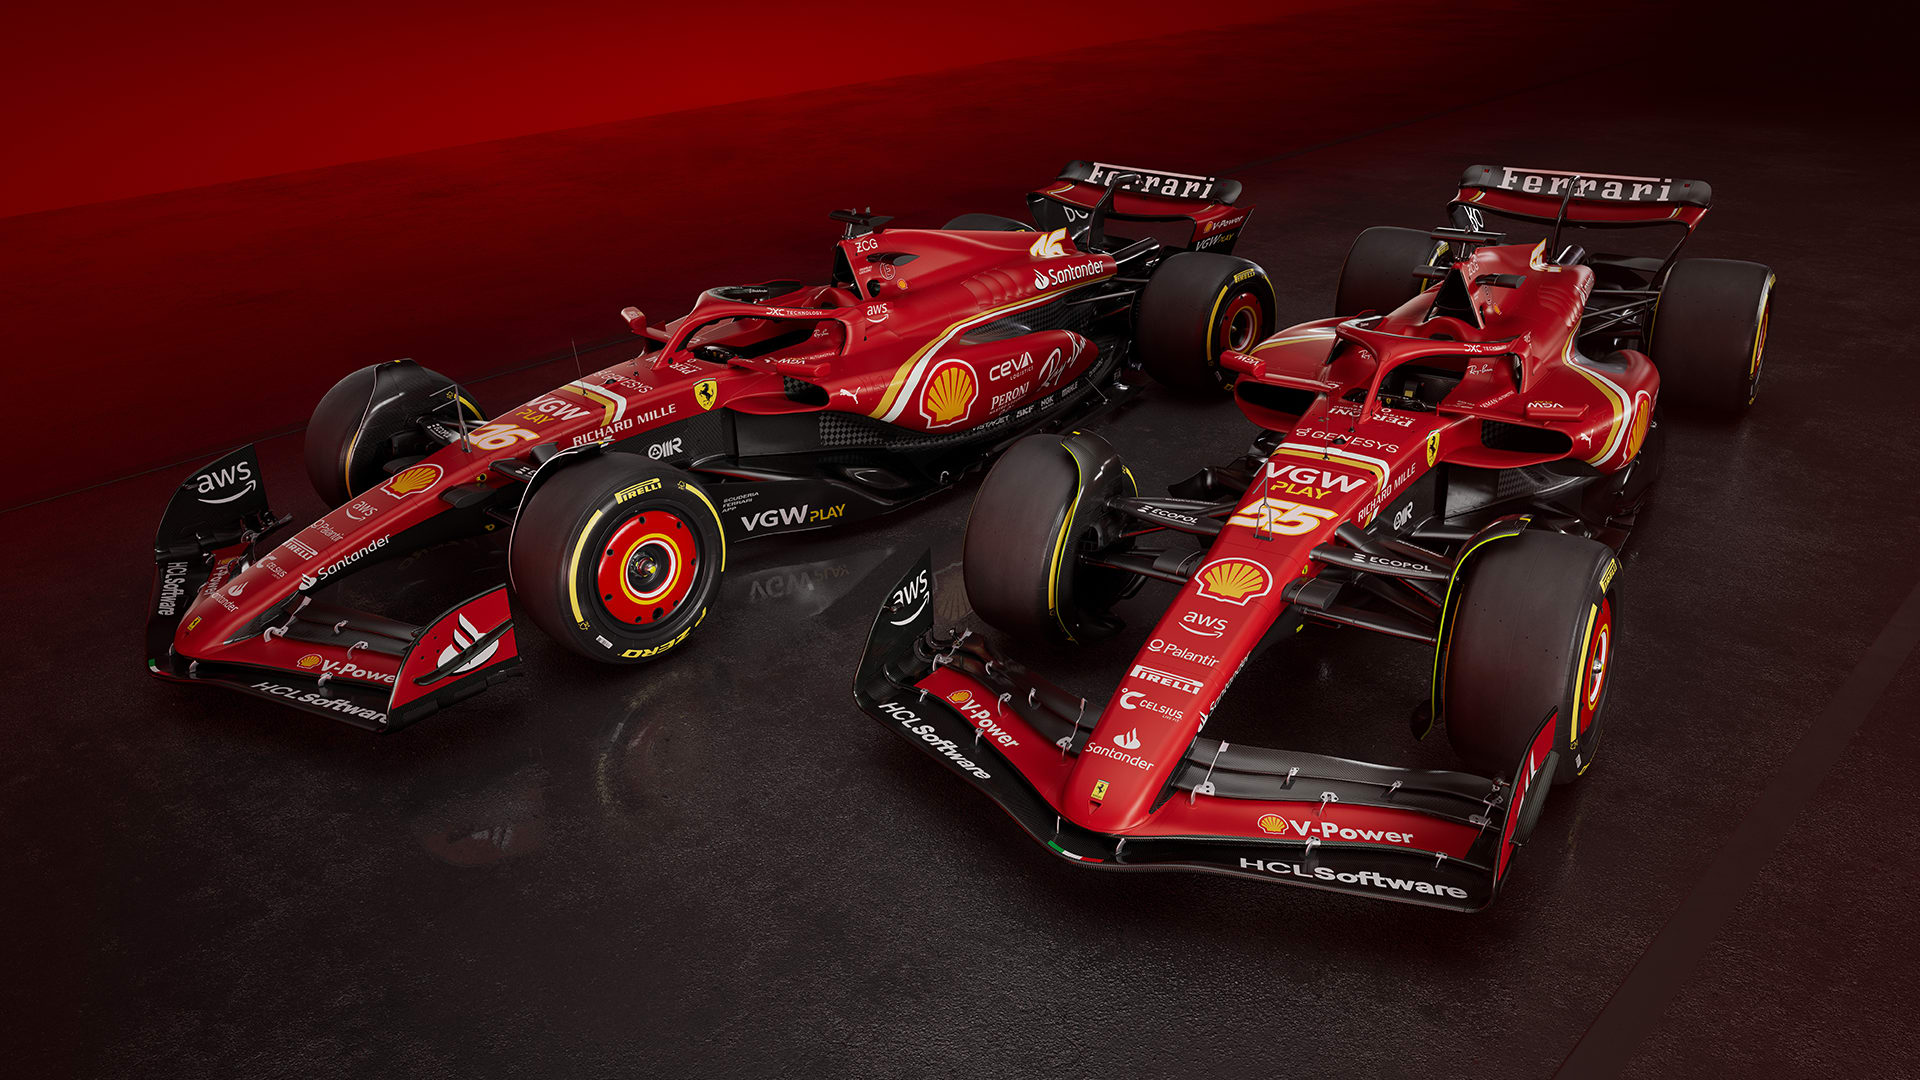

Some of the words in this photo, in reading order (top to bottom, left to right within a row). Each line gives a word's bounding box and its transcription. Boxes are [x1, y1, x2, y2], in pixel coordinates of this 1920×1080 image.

[1497, 167, 1672, 202] Ferrari
[1029, 227, 1071, 258] 16
[1049, 260, 1104, 287] Santander
[866, 303, 888, 316] aws
[526, 394, 591, 422] VGW
[991, 381, 1030, 411] PERONI
[516, 408, 555, 425] PLAY
[572, 418, 633, 447] RICHARD
[637, 403, 677, 425] MILLE
[466, 424, 541, 450] 16
[1311, 431, 1399, 454] GENESYS
[197, 461, 252, 494] aws
[614, 477, 662, 505] PIRELLI
[1266, 462, 1367, 494] VGW
[1270, 481, 1333, 500] PLAY
[1358, 486, 1392, 523] RICHARD
[1394, 462, 1417, 491] MILLE
[352, 500, 378, 517] aws
[741, 505, 808, 532] VGW
[809, 504, 846, 522] PLAY
[1152, 508, 1198, 524] ECOPOL
[1225, 496, 1339, 536] 55
[317, 534, 391, 580] Santander
[1369, 556, 1432, 572] ECOPOL
[158, 561, 189, 616] HCLSoftware
[893, 569, 928, 605] aws
[1183, 610, 1229, 631] aws
[621, 627, 691, 659] ZERO
[1163, 642, 1220, 668] Palantir
[321, 659, 395, 684] V-Powe
[1130, 664, 1204, 695] PIRELLI
[251, 681, 388, 725] HCLSoftwar
[1139, 699, 1184, 719] CELSIUS
[960, 699, 1020, 748] V-Power
[878, 702, 991, 781] HCLSoftware
[1085, 741, 1155, 772] Santander
[1289, 819, 1414, 844] V-Power
[1240, 857, 1469, 900] HCLSoftware
